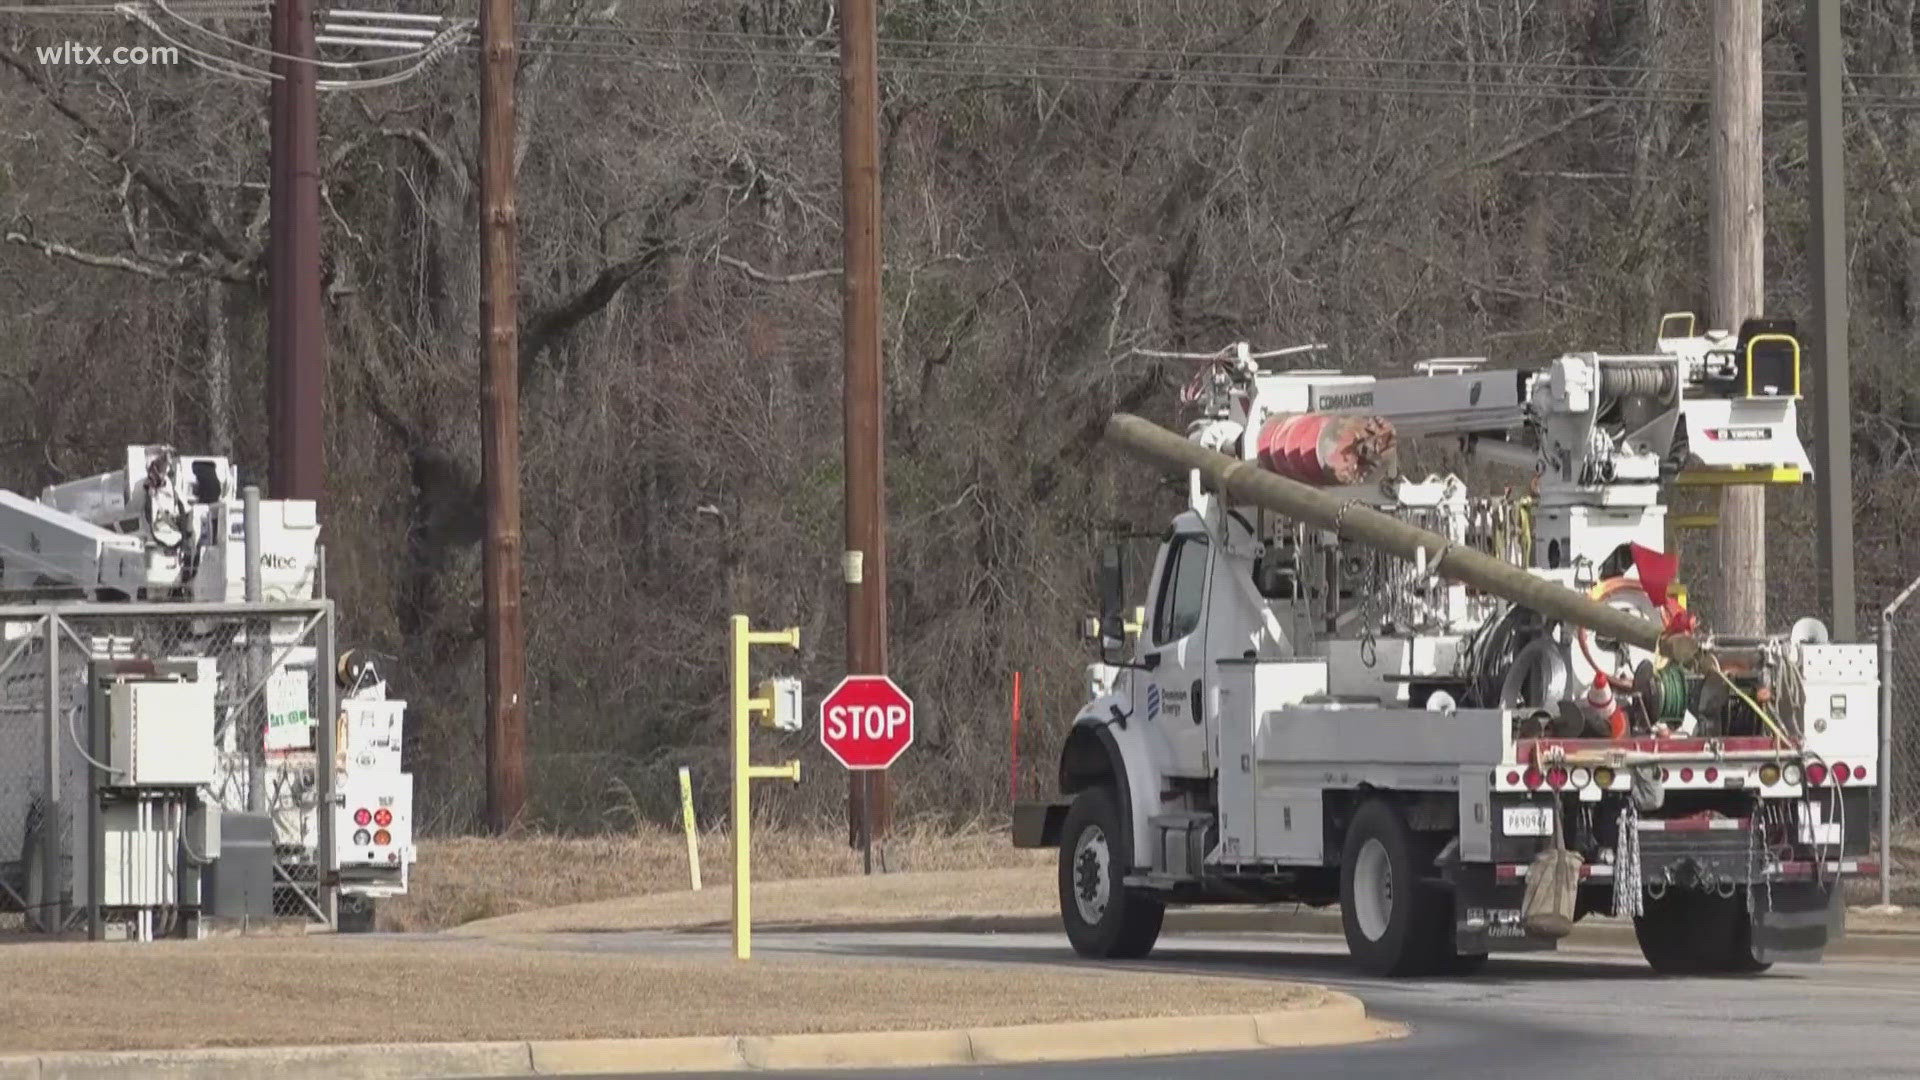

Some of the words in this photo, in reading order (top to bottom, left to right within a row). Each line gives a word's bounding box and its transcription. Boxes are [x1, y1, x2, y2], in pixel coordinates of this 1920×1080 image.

[1319, 391, 1374, 410] COMMANDER
[260, 553, 297, 569] Altec
[1162, 688, 1187, 700] Dominion
[1162, 702, 1181, 717] Energy
[828, 705, 906, 740] STOP
